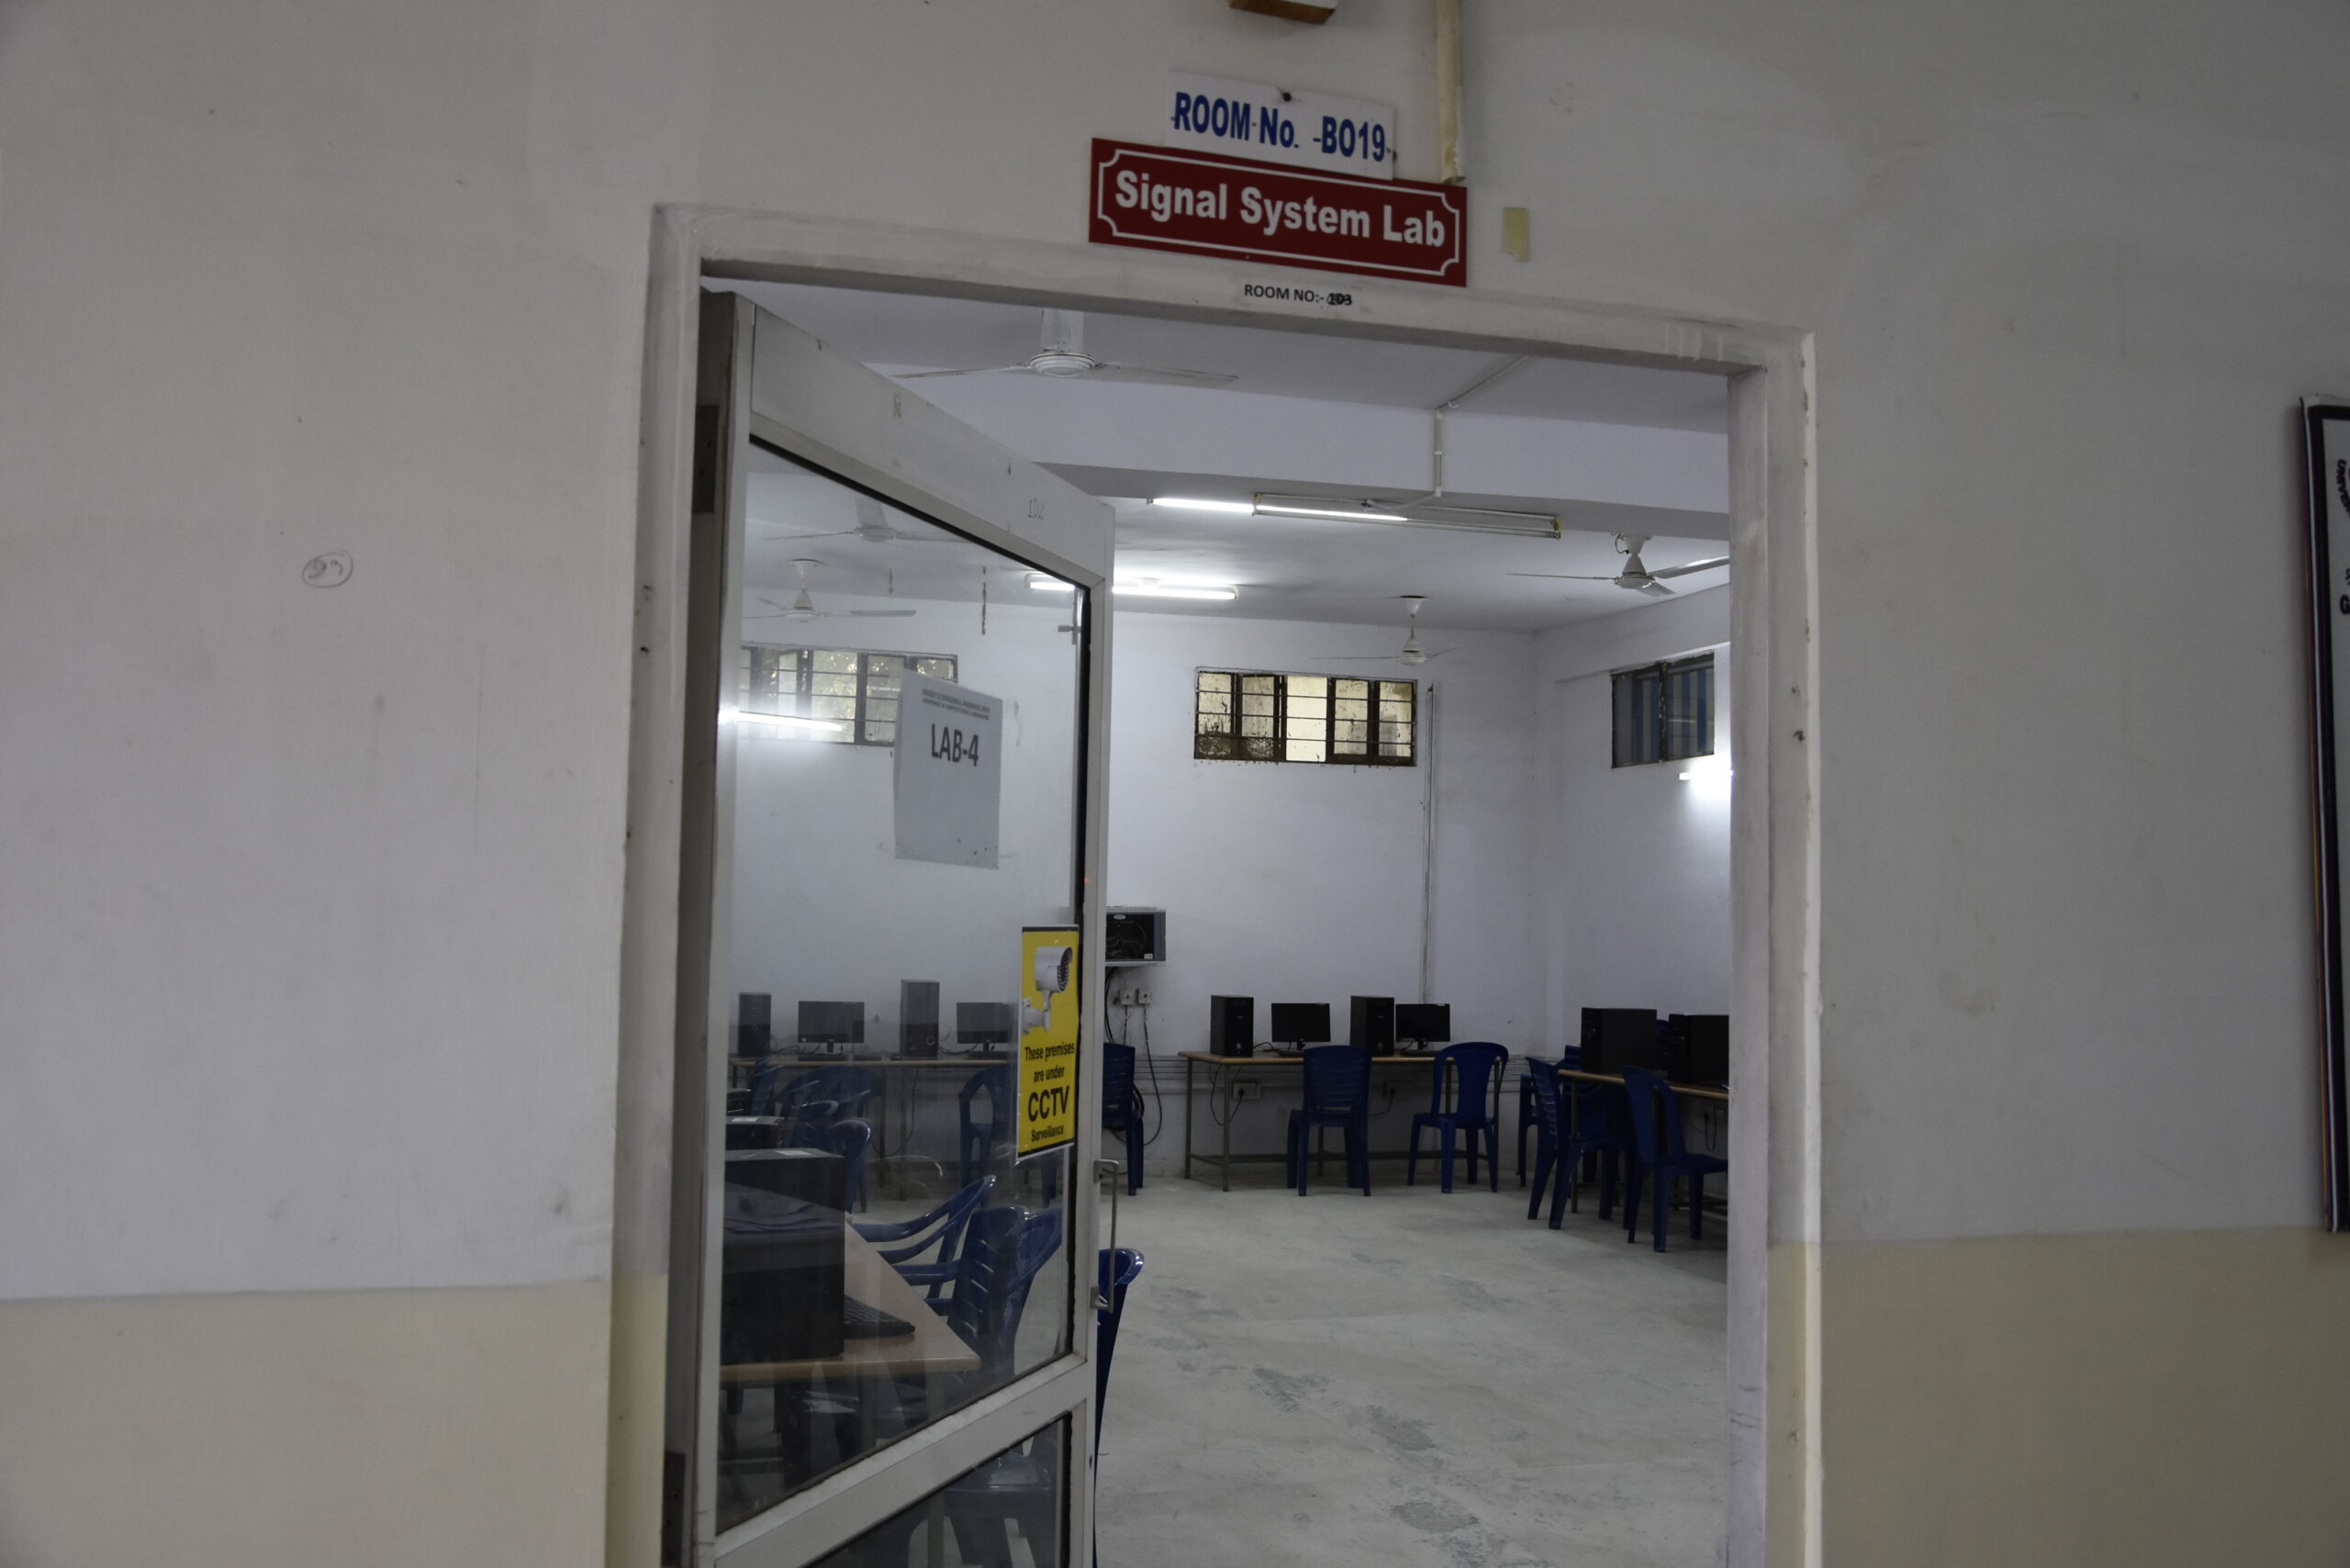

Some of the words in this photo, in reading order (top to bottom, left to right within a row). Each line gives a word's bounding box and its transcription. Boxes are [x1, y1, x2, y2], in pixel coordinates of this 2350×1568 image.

[1173, 91, 1250, 141] ROOM
[1259, 106, 1299, 149] No.
[1114, 170, 1227, 223] Signal
[1240, 186, 1371, 238] System
[1382, 205, 1446, 248] Lab
[1244, 284, 1290, 300] ROOM
[931, 723, 979, 767] LAB-4
[1024, 1045, 1045, 1061] These
[1045, 1041, 1075, 1062] premises
[1033, 1070, 1045, 1082] are
[1046, 1066, 1065, 1081] under
[1027, 1086, 1070, 1122] CCTV
[1031, 1124, 1065, 1142] Surveillance
